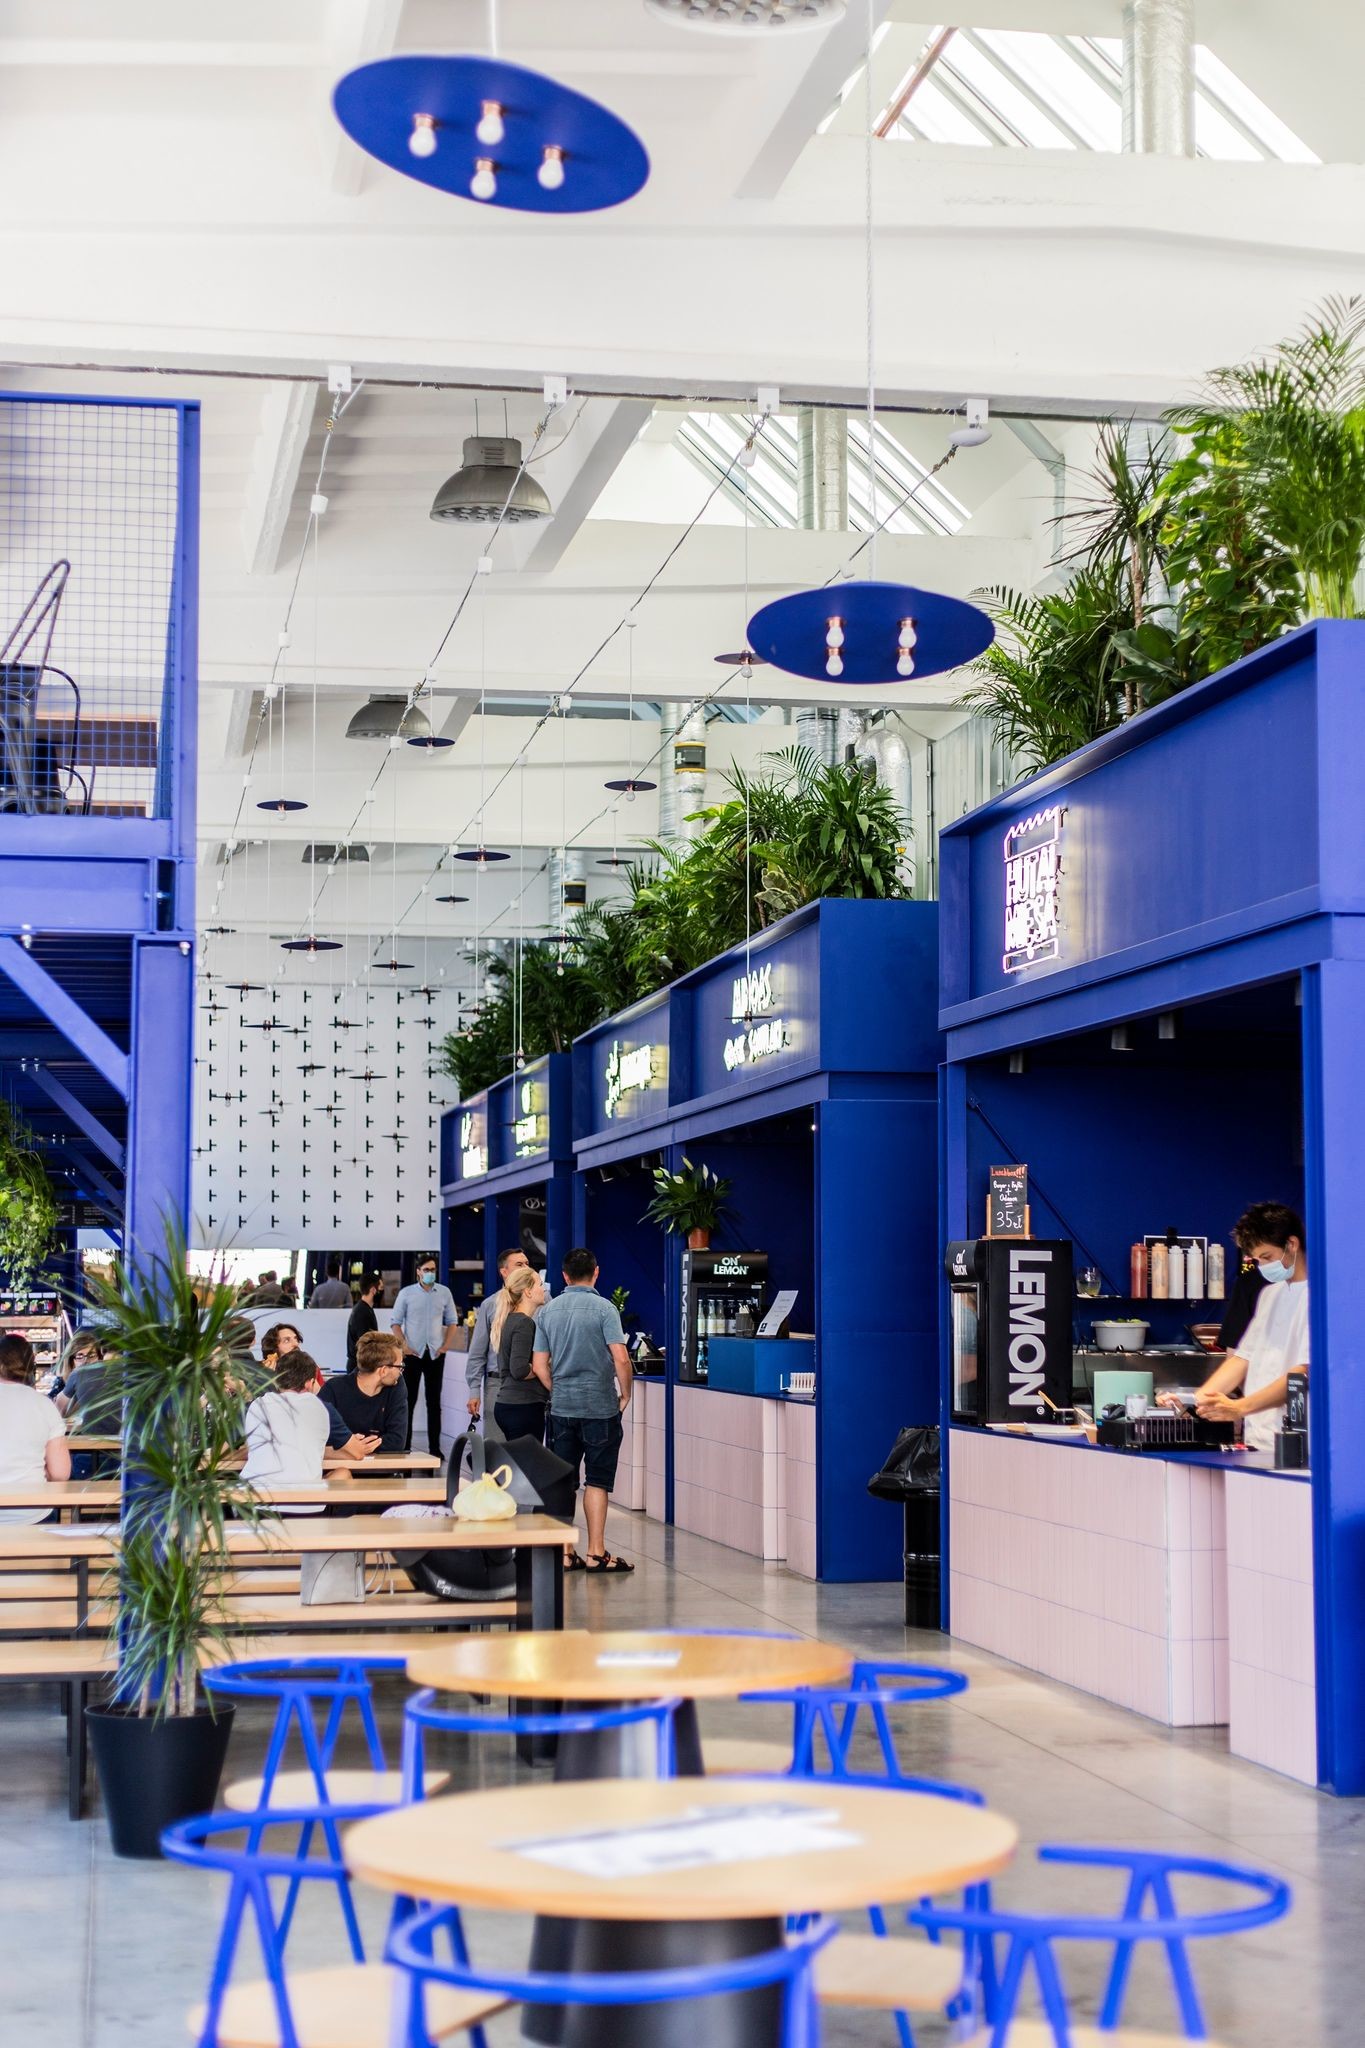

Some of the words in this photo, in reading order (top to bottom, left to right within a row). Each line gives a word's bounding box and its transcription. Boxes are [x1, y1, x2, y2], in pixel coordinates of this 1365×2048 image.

[713, 1263, 748, 1275] LEMON
[721, 1256, 740, 1266] ON
[681, 1253, 690, 1363] LEMON
[1009, 1250, 1053, 1405] LEMON
